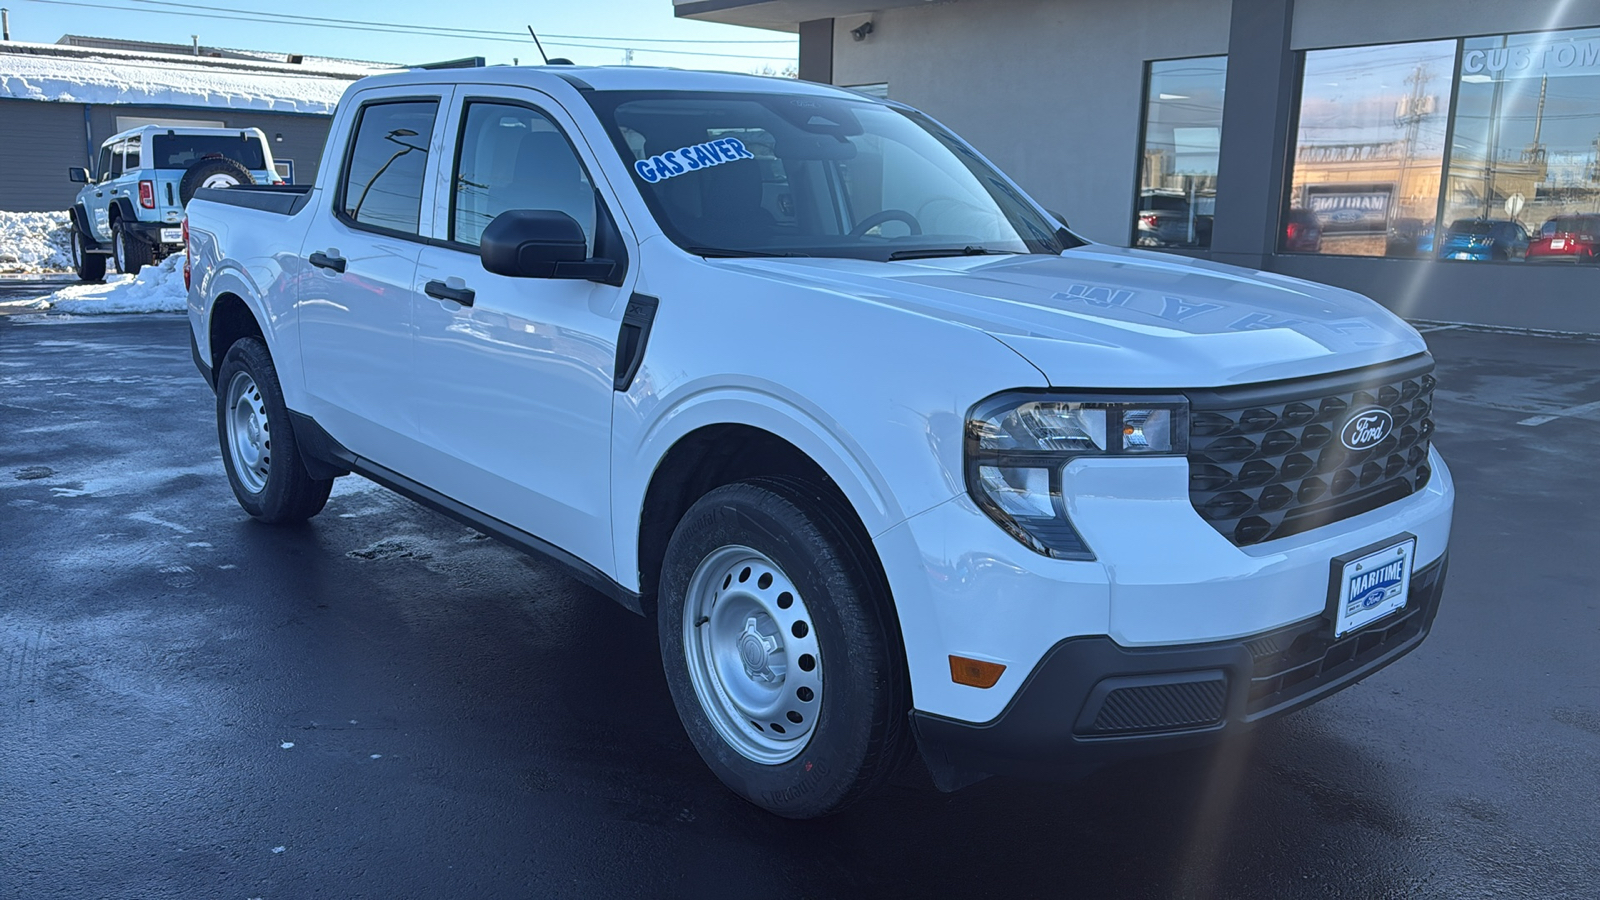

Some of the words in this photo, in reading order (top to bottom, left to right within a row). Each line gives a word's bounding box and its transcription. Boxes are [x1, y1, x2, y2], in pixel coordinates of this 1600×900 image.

[1465, 42, 1600, 73] CUSTOM
[636, 152, 684, 182] GAS
[680, 138, 753, 169] SAVER
[1351, 415, 1385, 445] Ford
[1349, 560, 1403, 602] MARITIME
[1366, 592, 1382, 606] Ford
